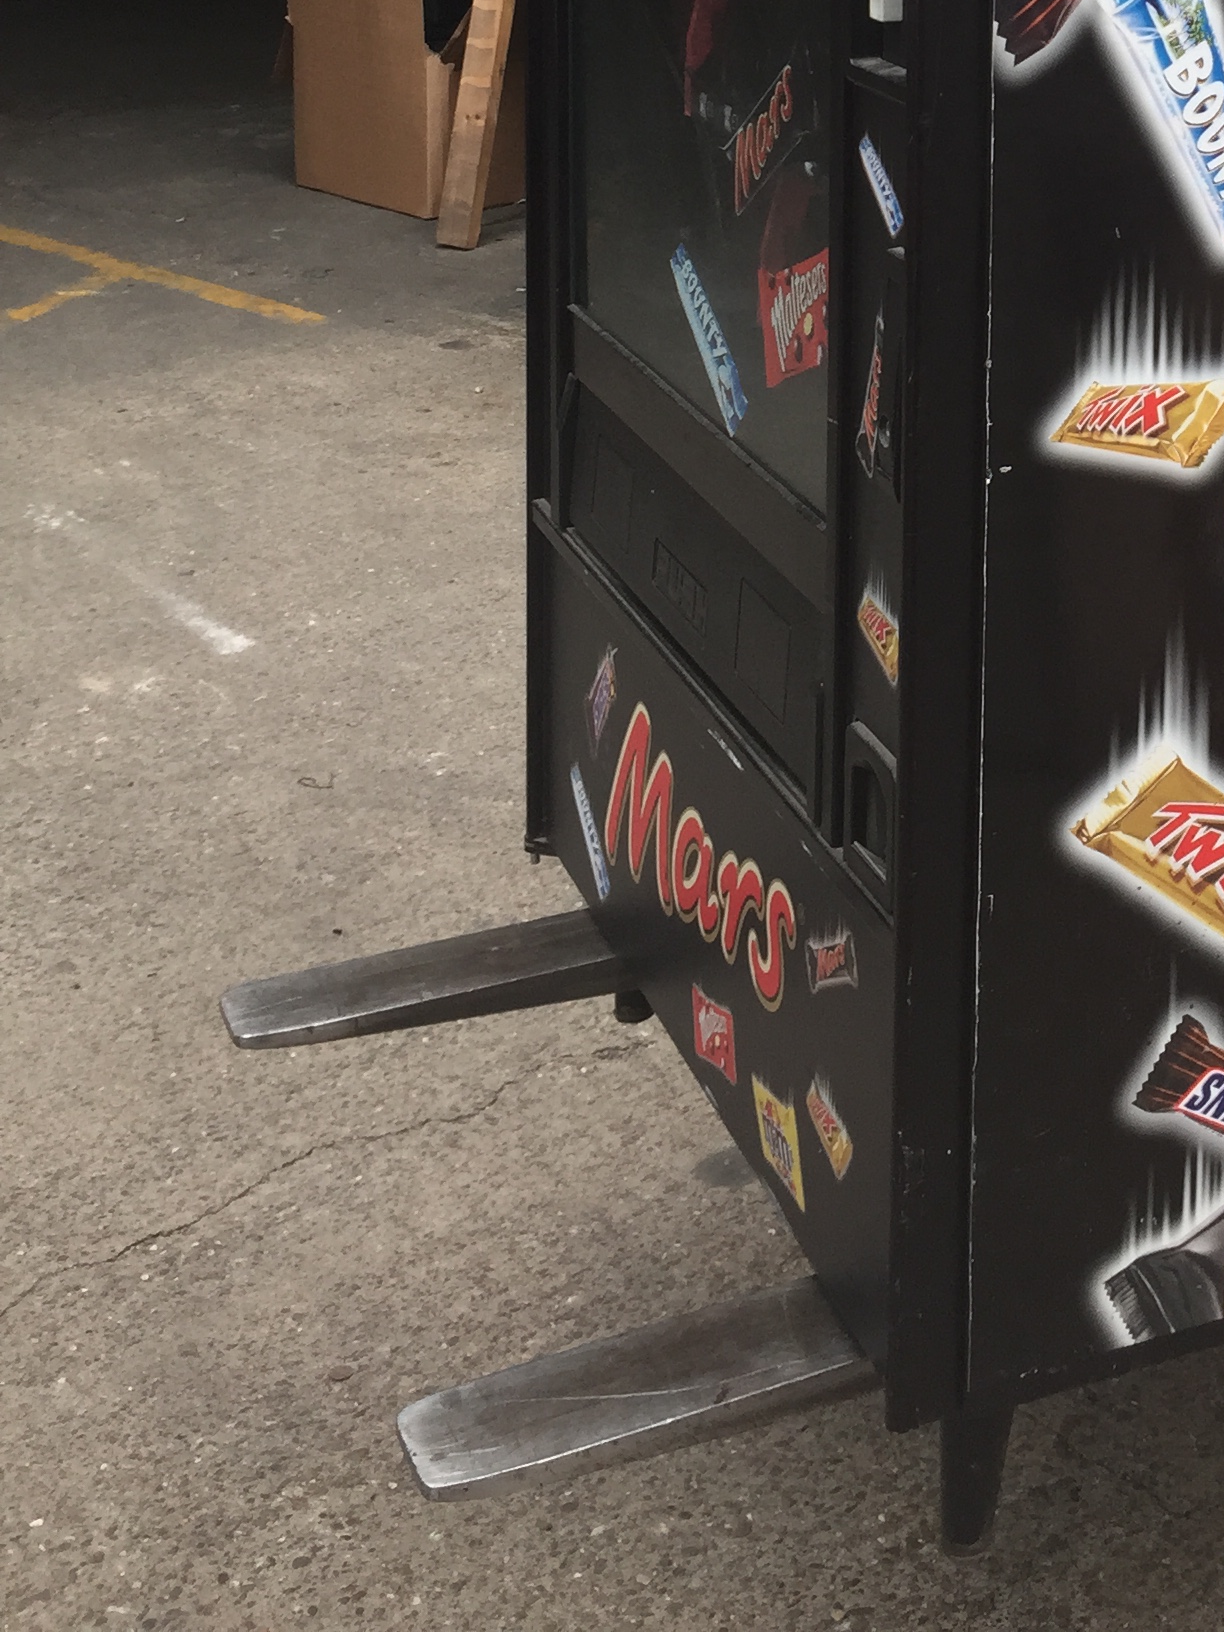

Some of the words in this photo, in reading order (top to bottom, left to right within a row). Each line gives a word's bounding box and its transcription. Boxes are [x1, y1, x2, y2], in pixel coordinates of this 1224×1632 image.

[734, 65, 793, 214] Mars
[680, 252, 728, 360] BOUNTY
[770, 260, 827, 373] Maltesers
[605, 701, 796, 1012] Mars
